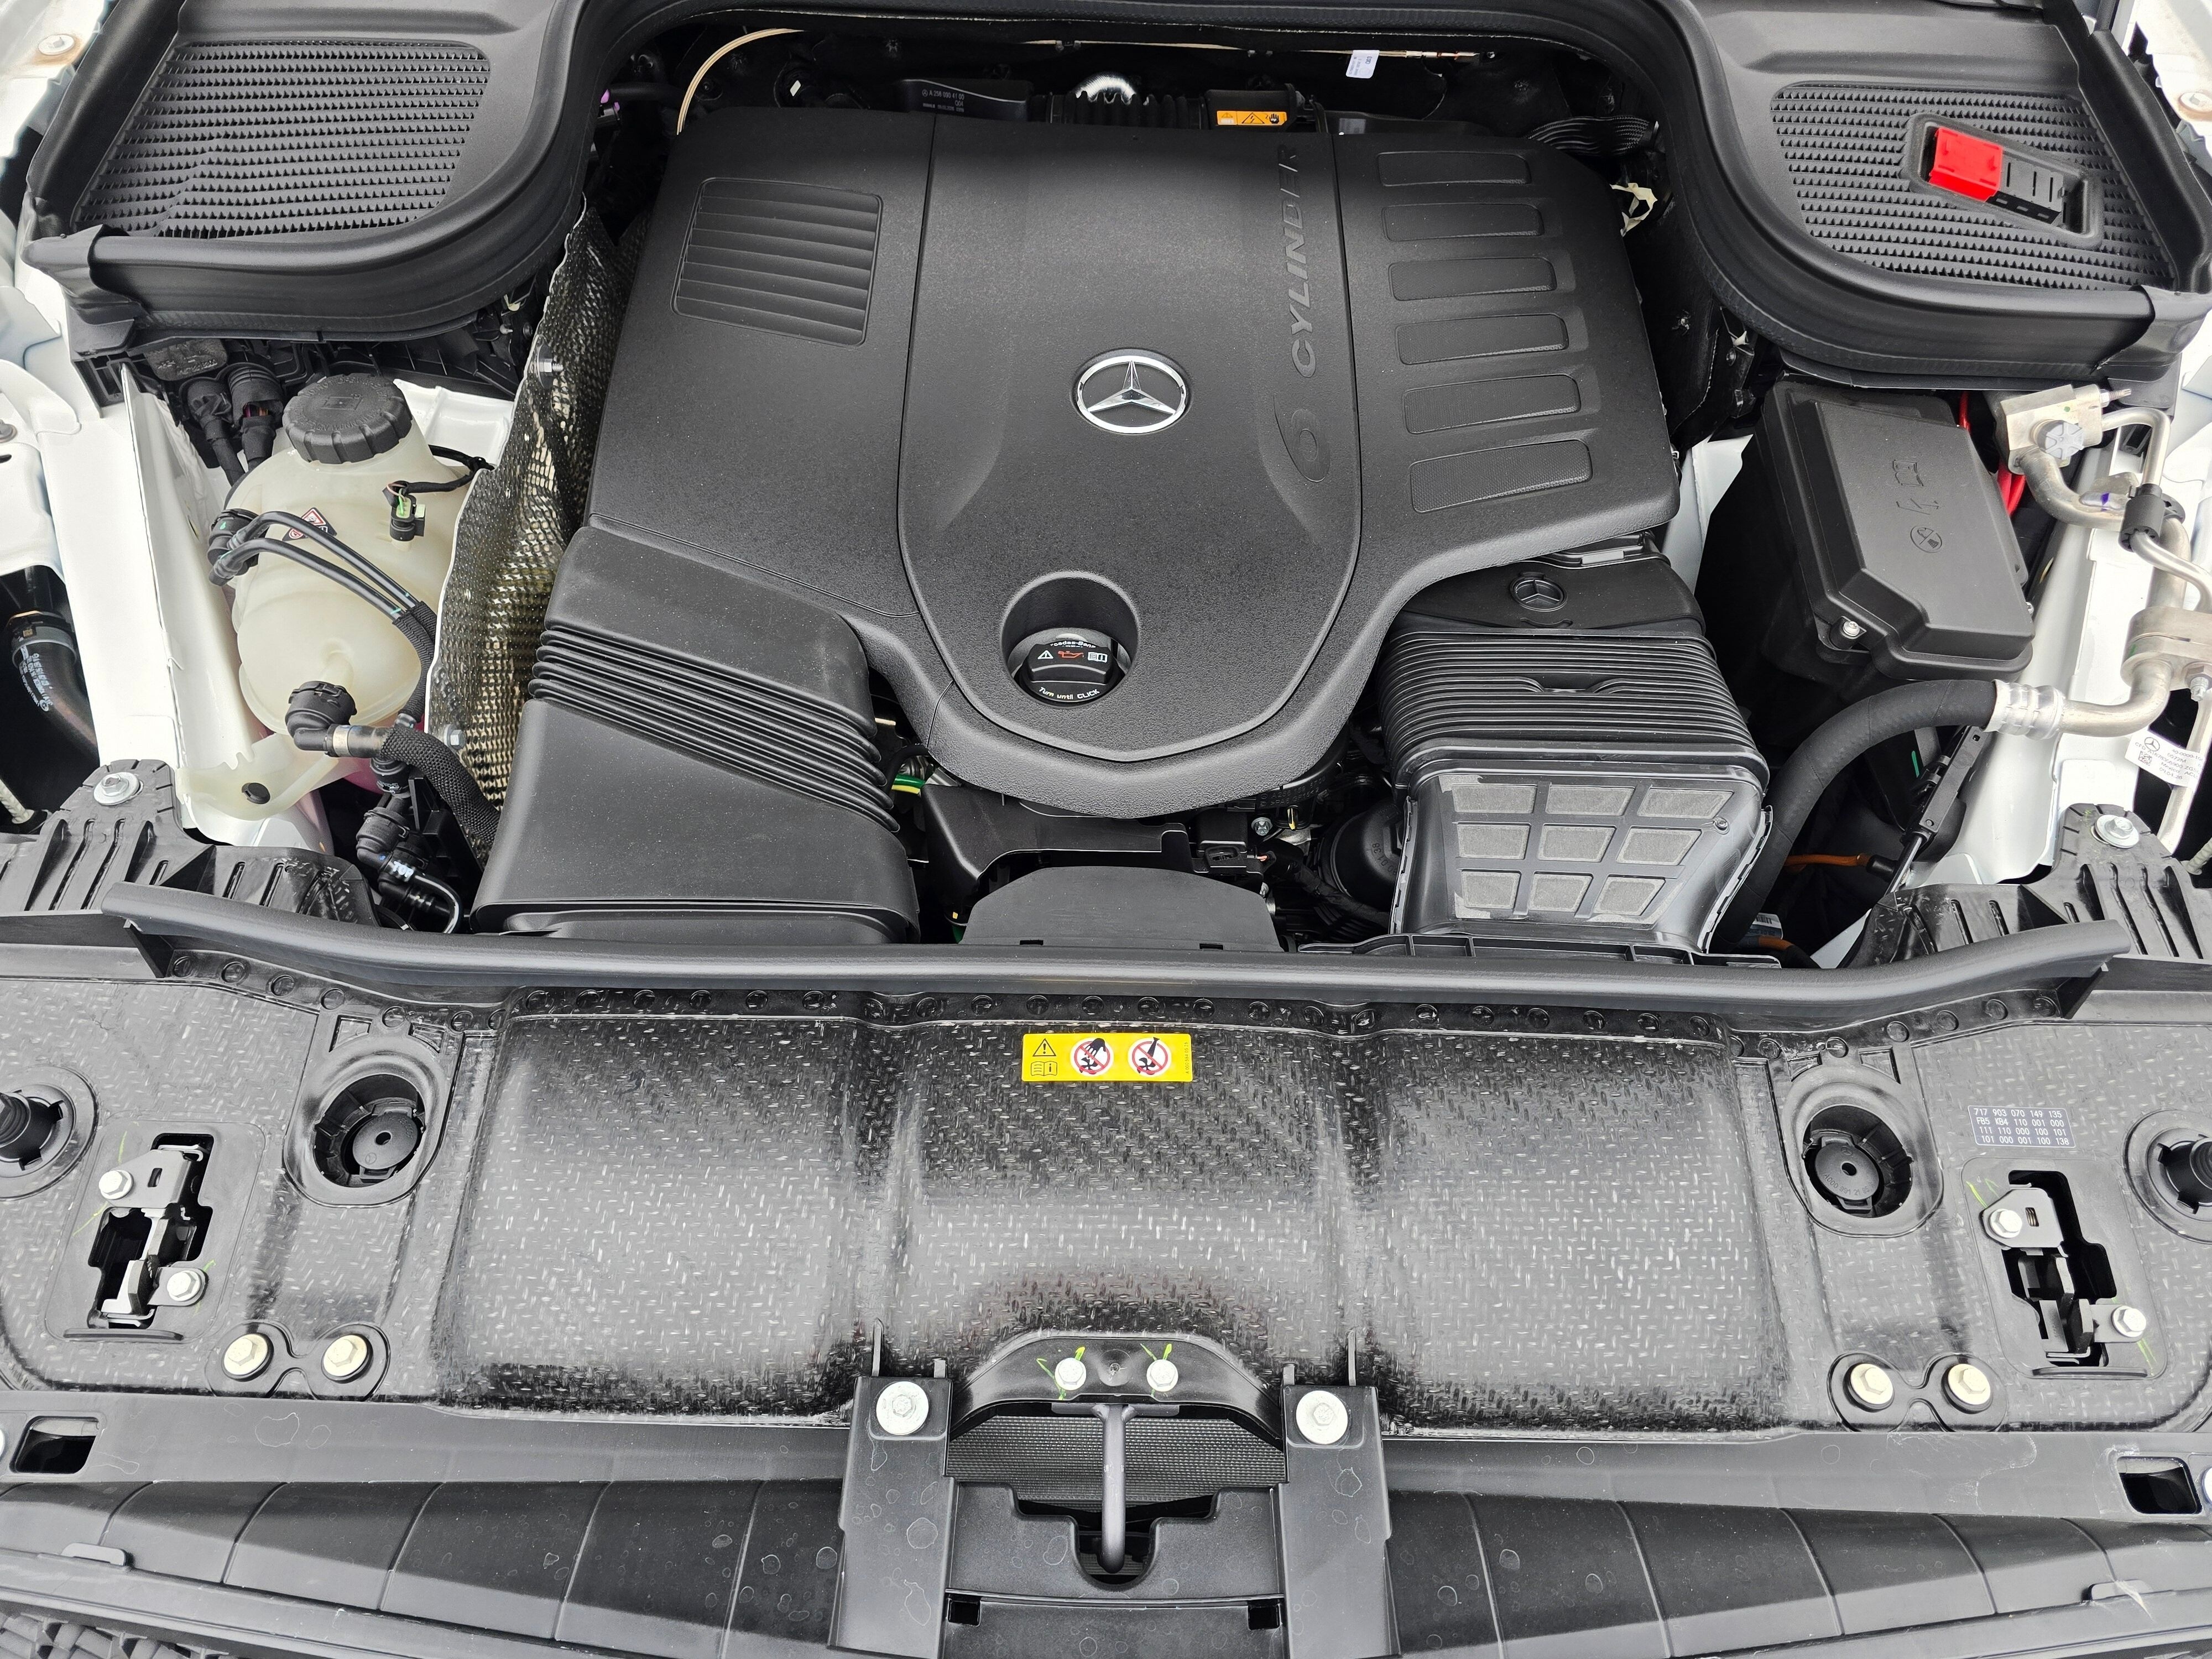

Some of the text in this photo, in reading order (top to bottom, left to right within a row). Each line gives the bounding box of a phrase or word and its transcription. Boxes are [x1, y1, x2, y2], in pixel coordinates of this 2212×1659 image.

[1278, 143, 1316, 378] CYLINDER
[1039, 687, 1055, 697] Turn
[1077, 688, 1100, 699] CLICK
[1372, 842, 1381, 854] 38
[393, 860, 414, 878] TOP
[1823, 1173, 1839, 1188] A000
[1839, 1186, 1851, 1195] 991
